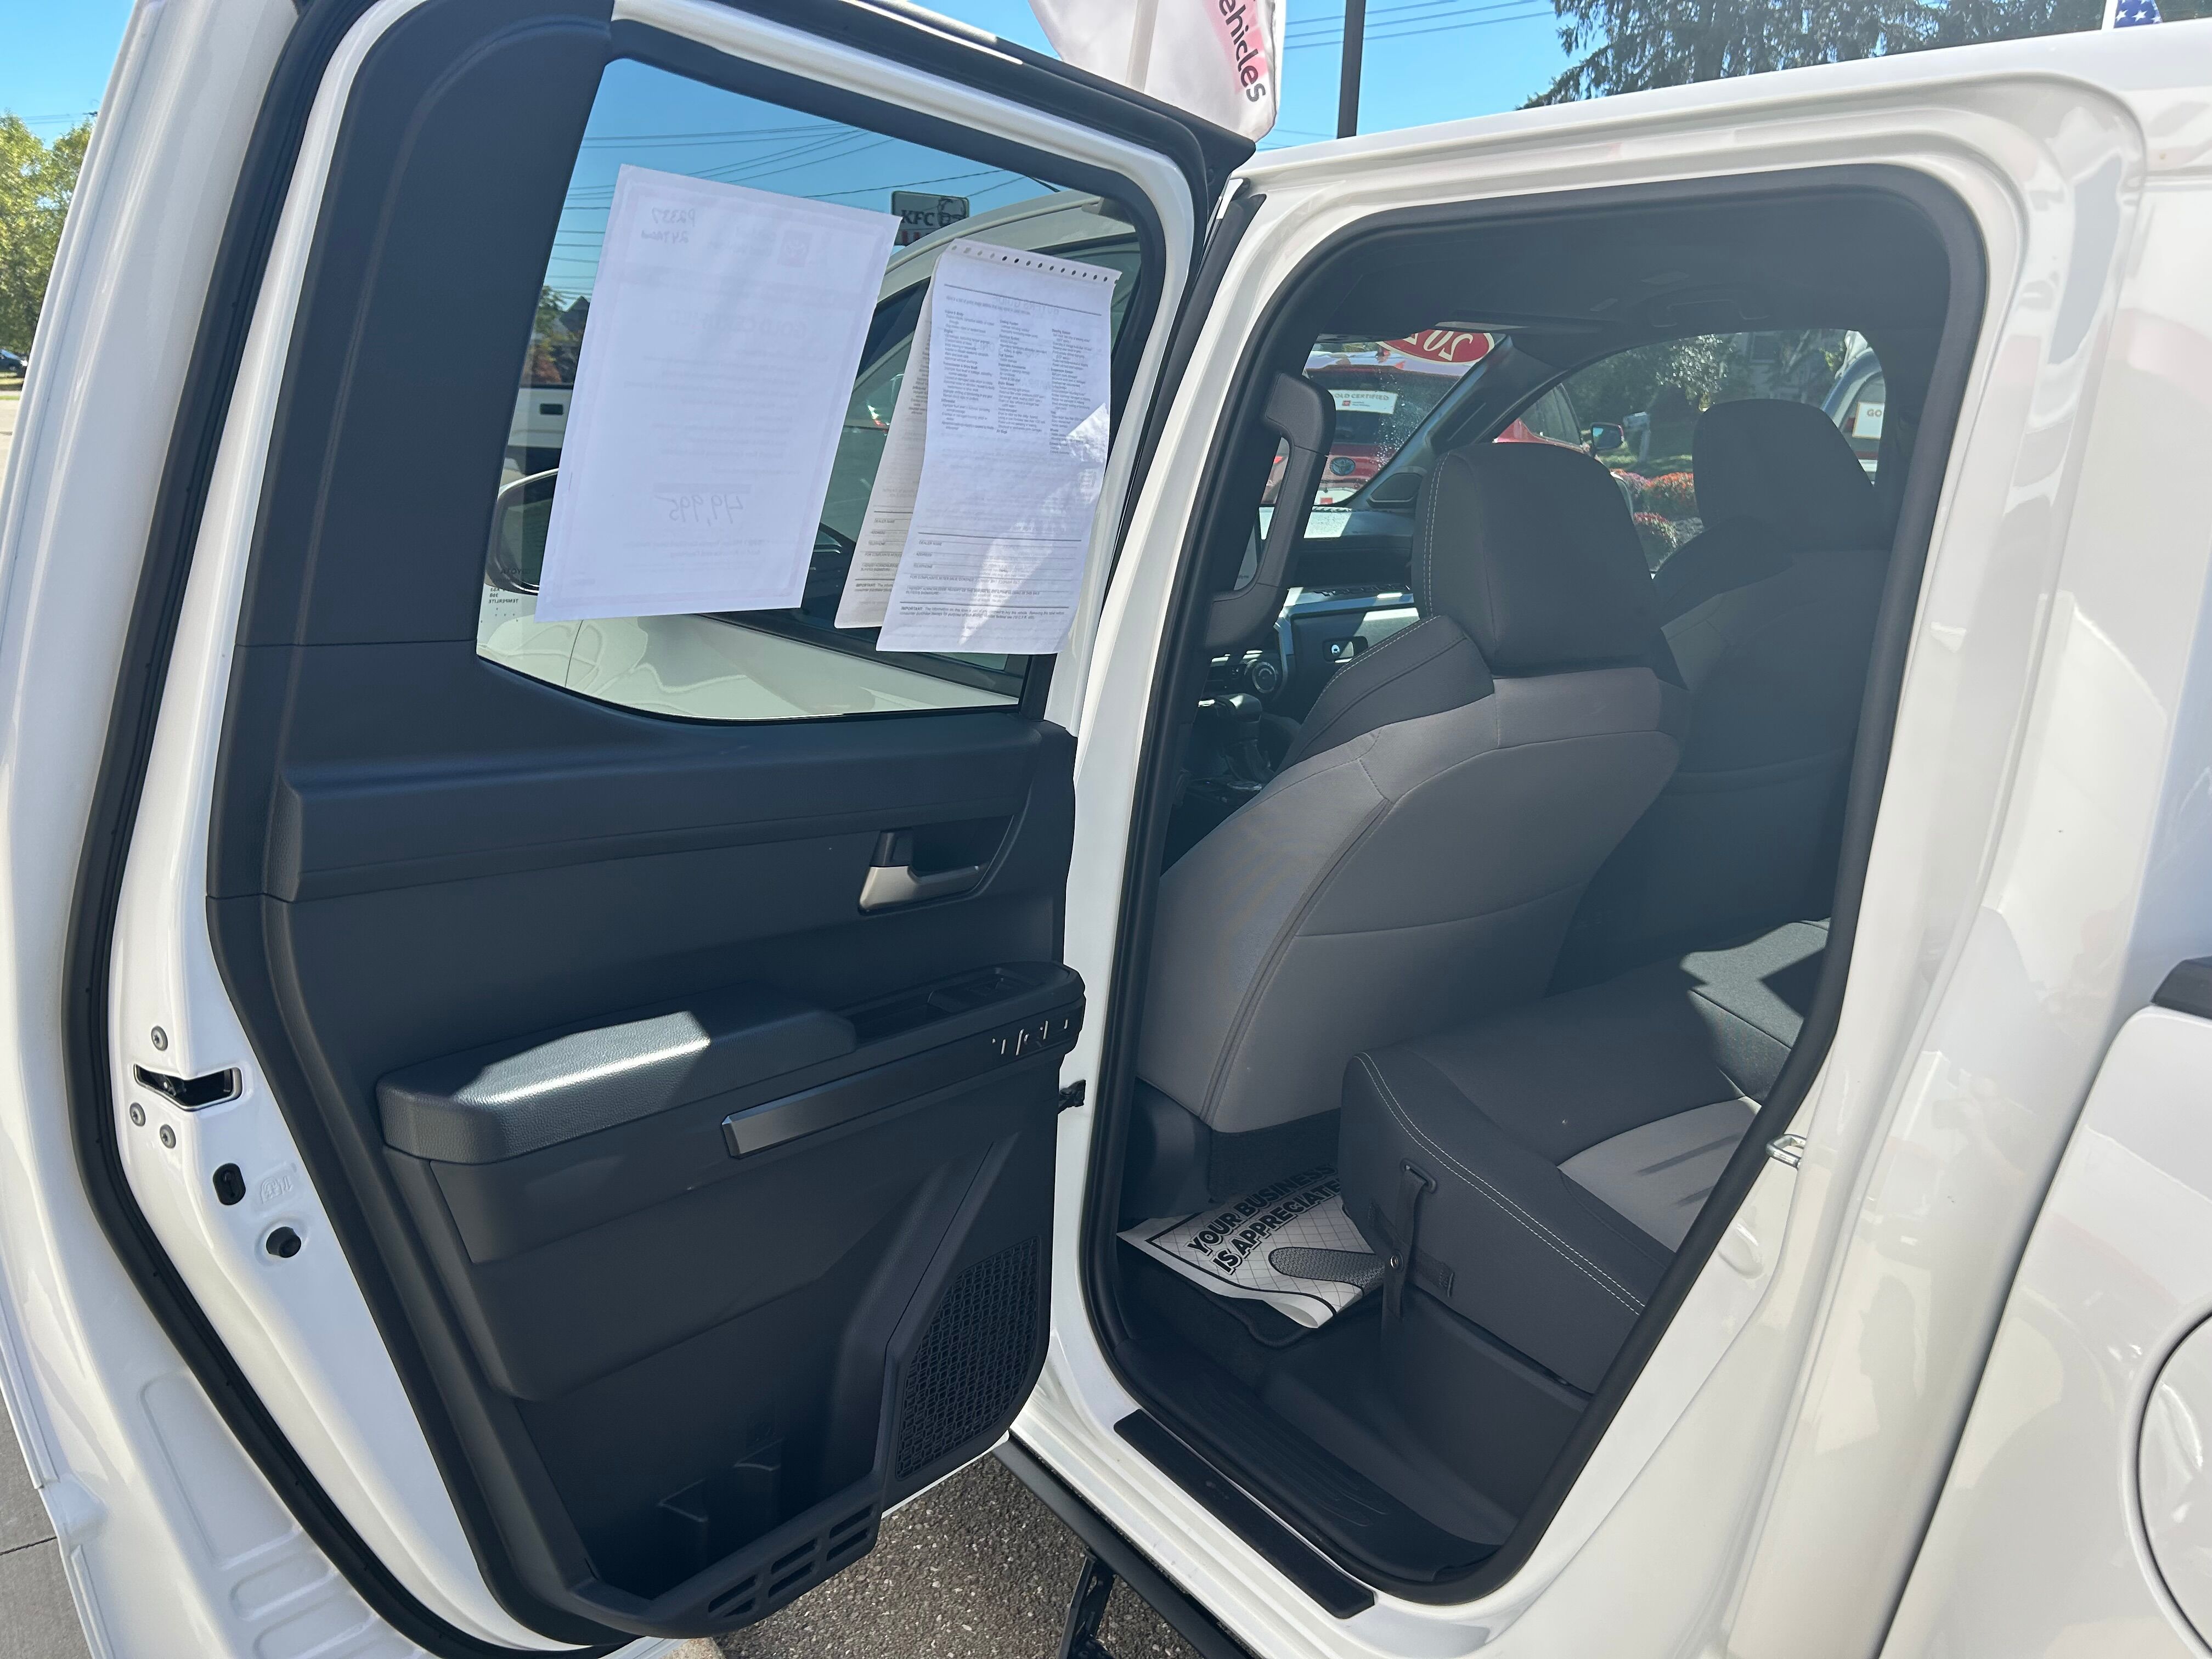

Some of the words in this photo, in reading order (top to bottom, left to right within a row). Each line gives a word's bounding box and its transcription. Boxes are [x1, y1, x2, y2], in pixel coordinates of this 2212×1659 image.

[1218, 0, 1266, 102] ehicles
[901, 210, 935, 226] KFC
[1867, 408, 1882, 417] GO
[1186, 1211, 1242, 1256] YOUR
[1233, 1166, 1338, 1217] BUSINESS
[1212, 1249, 1242, 1274] IS
[1231, 1177, 1341, 1257] APPRECIATE
